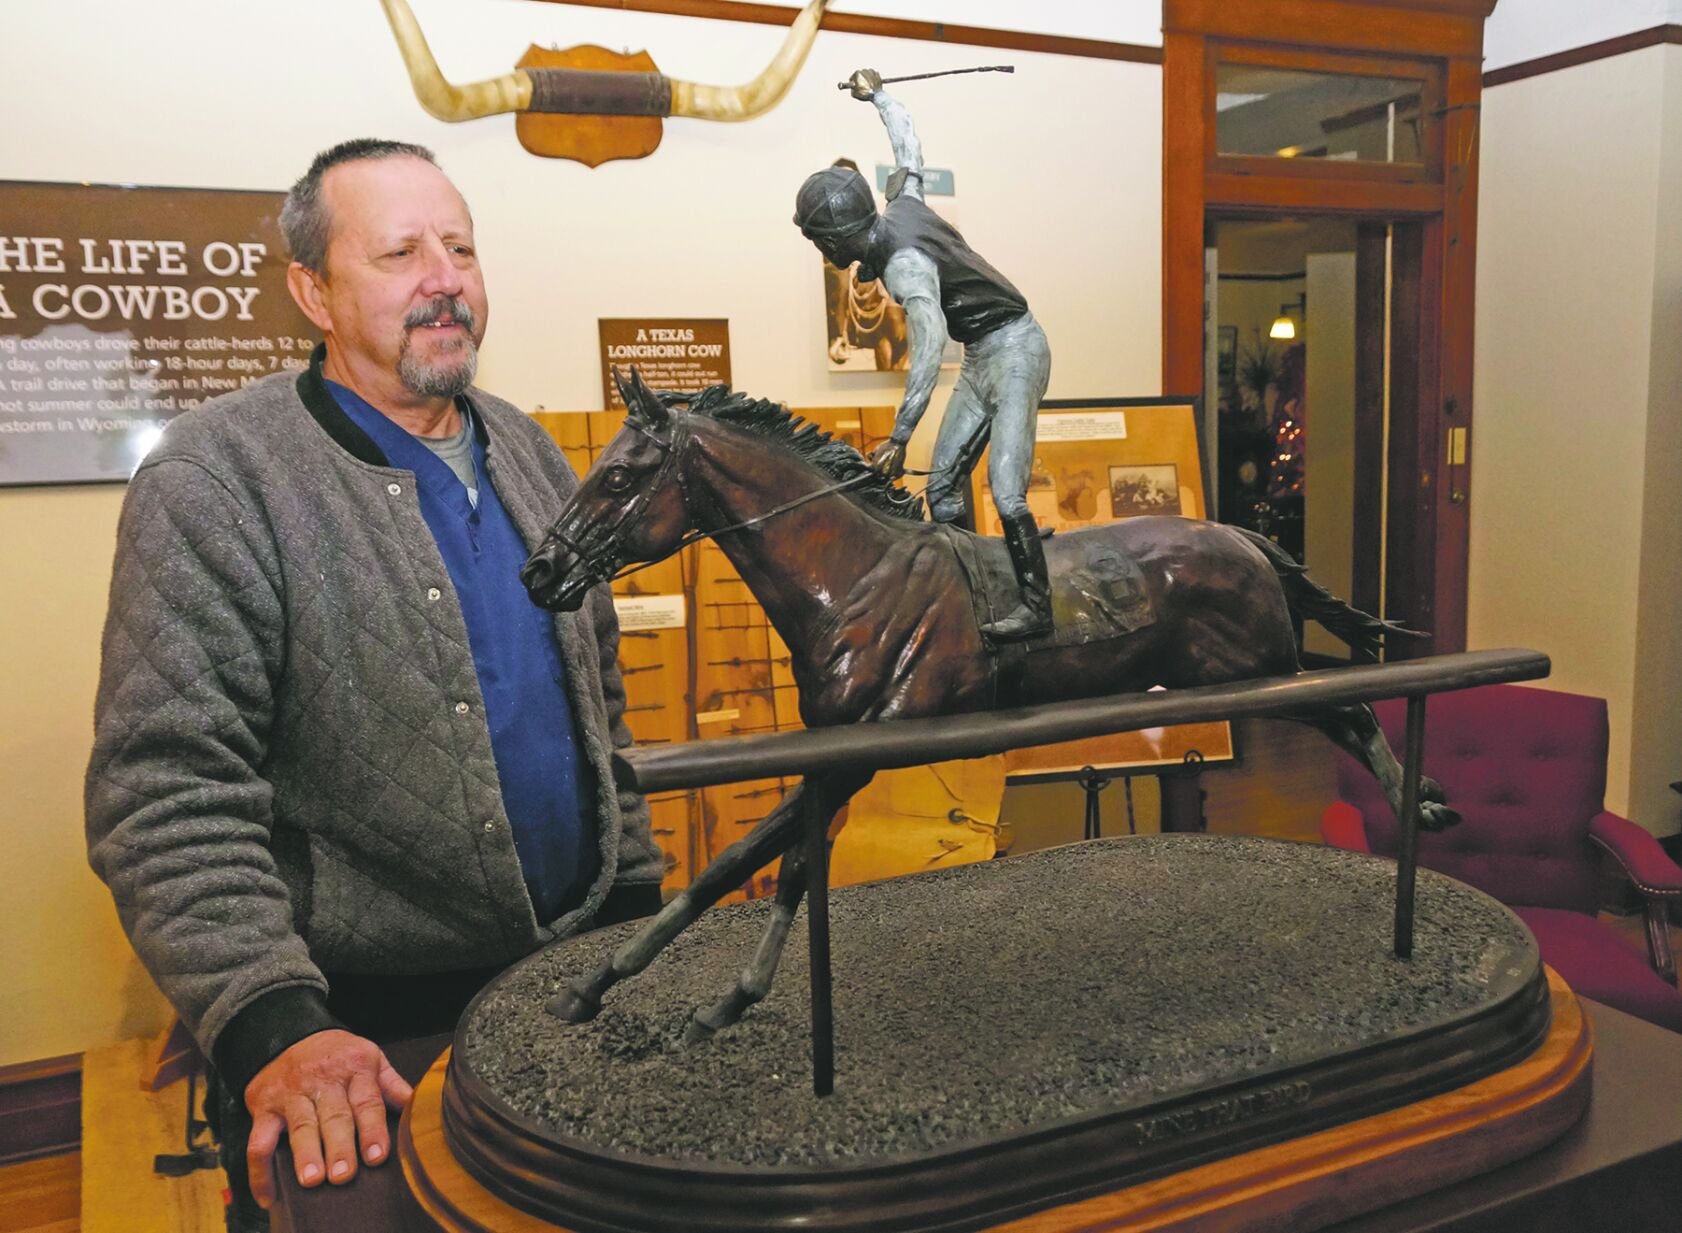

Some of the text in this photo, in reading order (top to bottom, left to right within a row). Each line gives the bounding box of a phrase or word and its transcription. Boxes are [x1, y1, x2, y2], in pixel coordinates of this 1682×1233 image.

[79, 238, 188, 275] LIFE
[203, 241, 267, 277] OF
[32, 283, 260, 320] COWBOY
[636, 329, 694, 342] A TEXAS
[20, 336, 90, 353] cowboys
[95, 336, 140, 350] drove
[144, 336, 180, 350] their
[184, 336, 274, 350] cattle-herds
[278, 336, 294, 350] 12
[298, 337, 314, 350] to
[608, 344, 722, 358] LONGHORN COW
[44, 356, 90, 370] often
[165, 356, 223, 370] 18-hour
[268, 356, 278, 369] 7
[10, 377, 43, 391] trail
[47, 377, 88, 391] drive
[92, 378, 125, 391] that
[129, 377, 179, 393] began
[183, 377, 198, 389] in
[202, 376, 238, 389] New
[28, 400, 94, 411] summer
[97, 396, 139, 410] could
[144, 395, 176, 410] end
[57, 417, 73, 430] in
